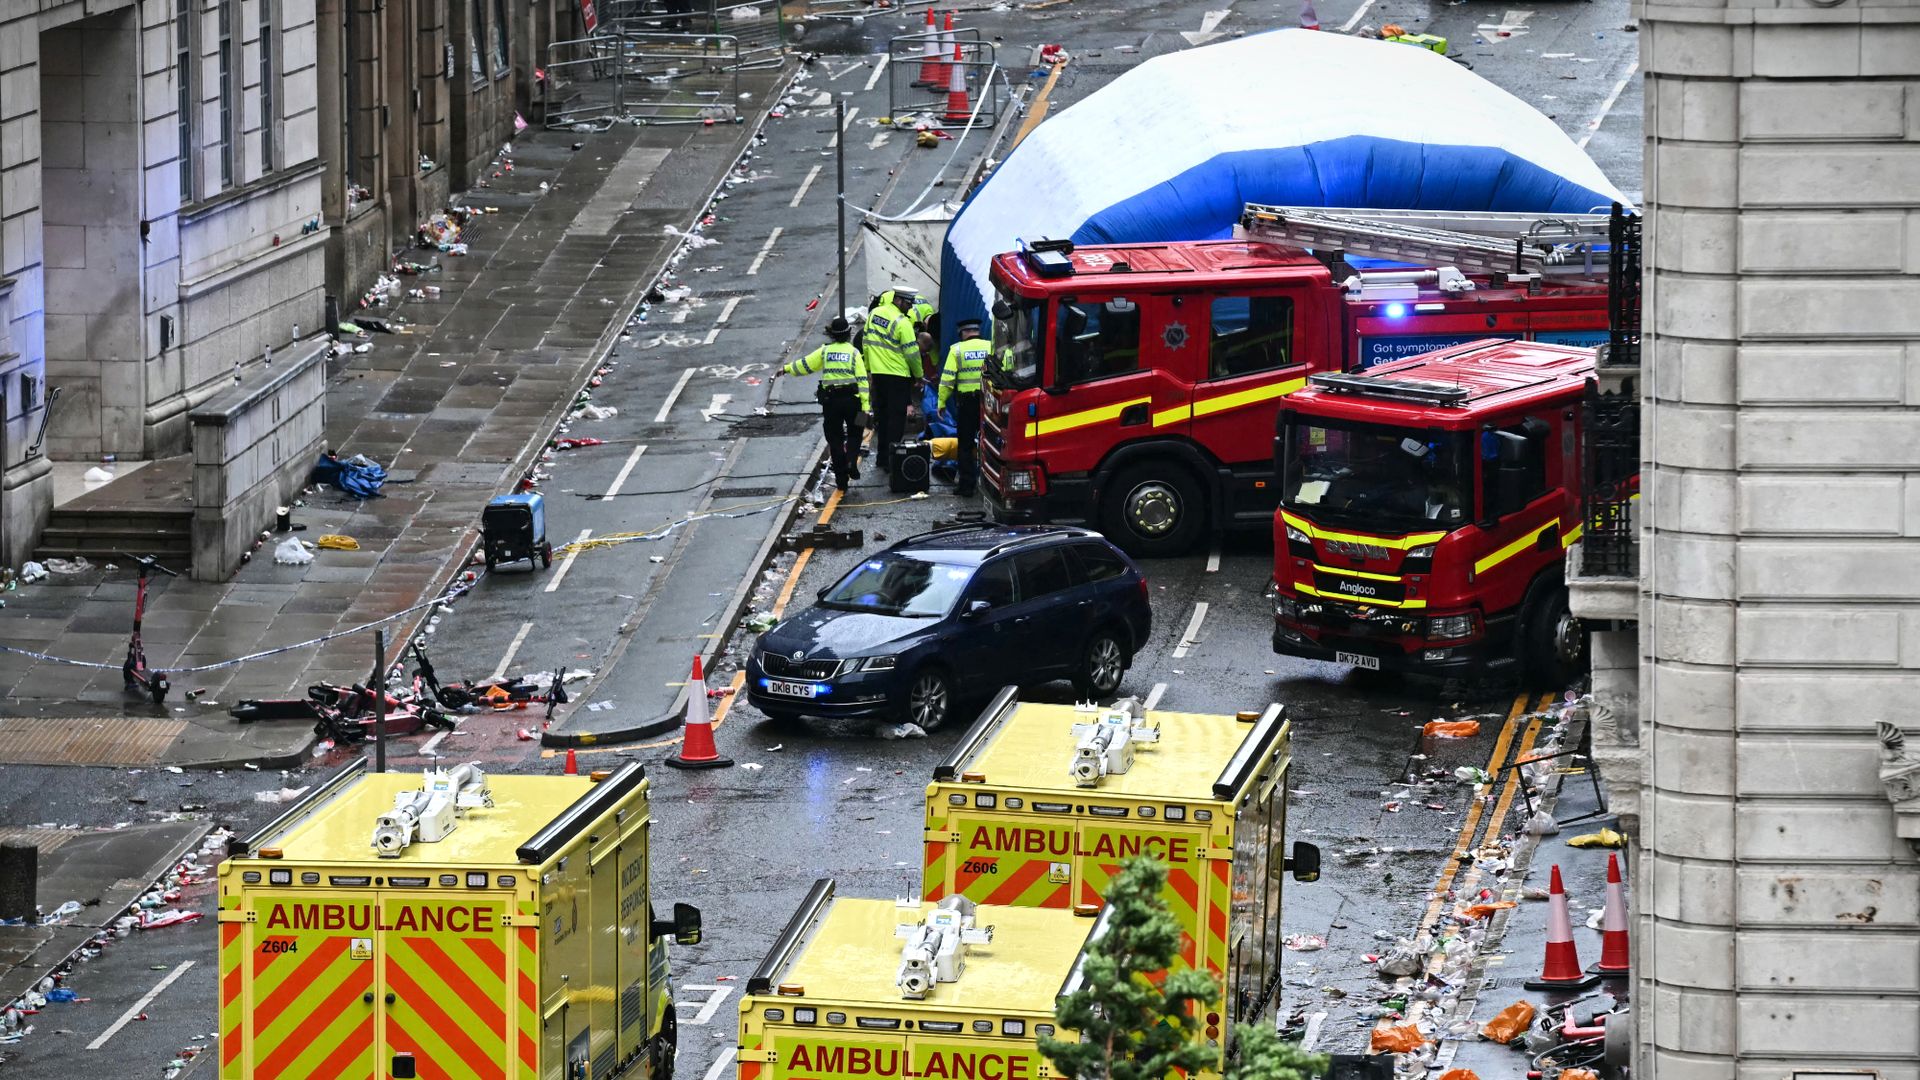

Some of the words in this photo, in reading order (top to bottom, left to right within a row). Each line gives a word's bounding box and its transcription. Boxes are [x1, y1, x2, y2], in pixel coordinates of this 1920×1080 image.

[872, 315, 890, 328] POLICE
[1373, 343, 1393, 353] Got
[827, 353, 849, 362] POLICE
[1325, 539, 1390, 560] SCANIA
[1339, 580, 1376, 595] Angloco
[1338, 652, 1360, 665] DK72
[1361, 656, 1377, 668] AVU
[772, 682, 791, 694] DK18
[792, 685, 810, 696] CYS
[969, 826, 1189, 863] AMBULANCE
[963, 861, 998, 874] Z606
[266, 904, 494, 932] AMBULANCE
[261, 940, 298, 953] Z604
[787, 1044, 1029, 1080] AMBULANCE
